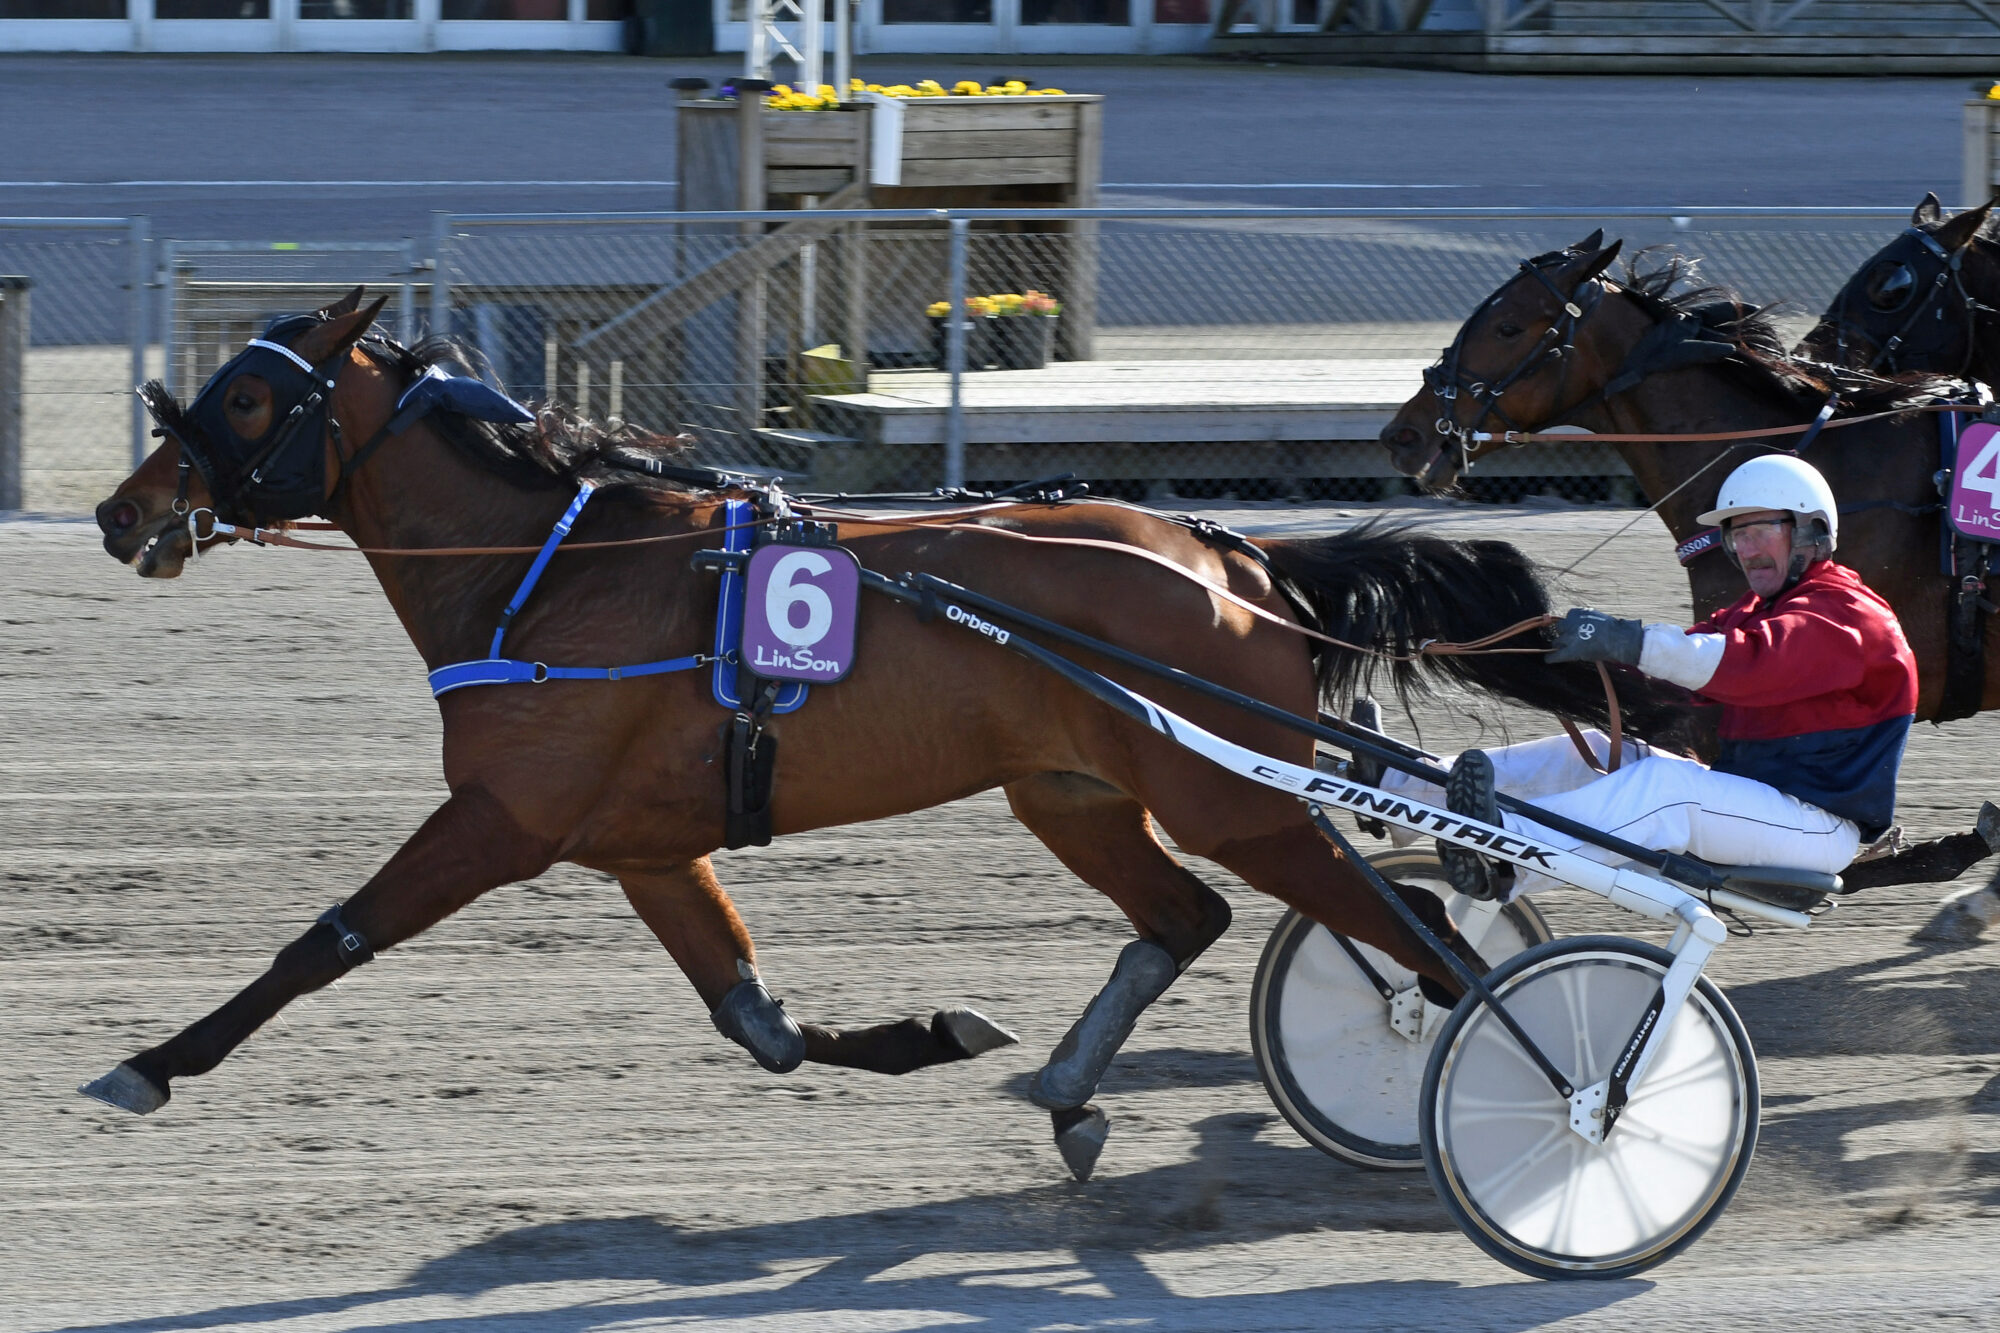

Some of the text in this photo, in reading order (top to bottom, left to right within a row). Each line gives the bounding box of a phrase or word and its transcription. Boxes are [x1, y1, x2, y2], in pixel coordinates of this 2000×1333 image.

[1961, 431, 2000, 510] 4
[765, 551, 833, 648] 6
[946, 605, 1010, 645] Orberg
[754, 645, 840, 673] LinSon
[1304, 778, 1560, 869] FINNTACK
[1615, 1009, 1657, 1078] CONTENDER
